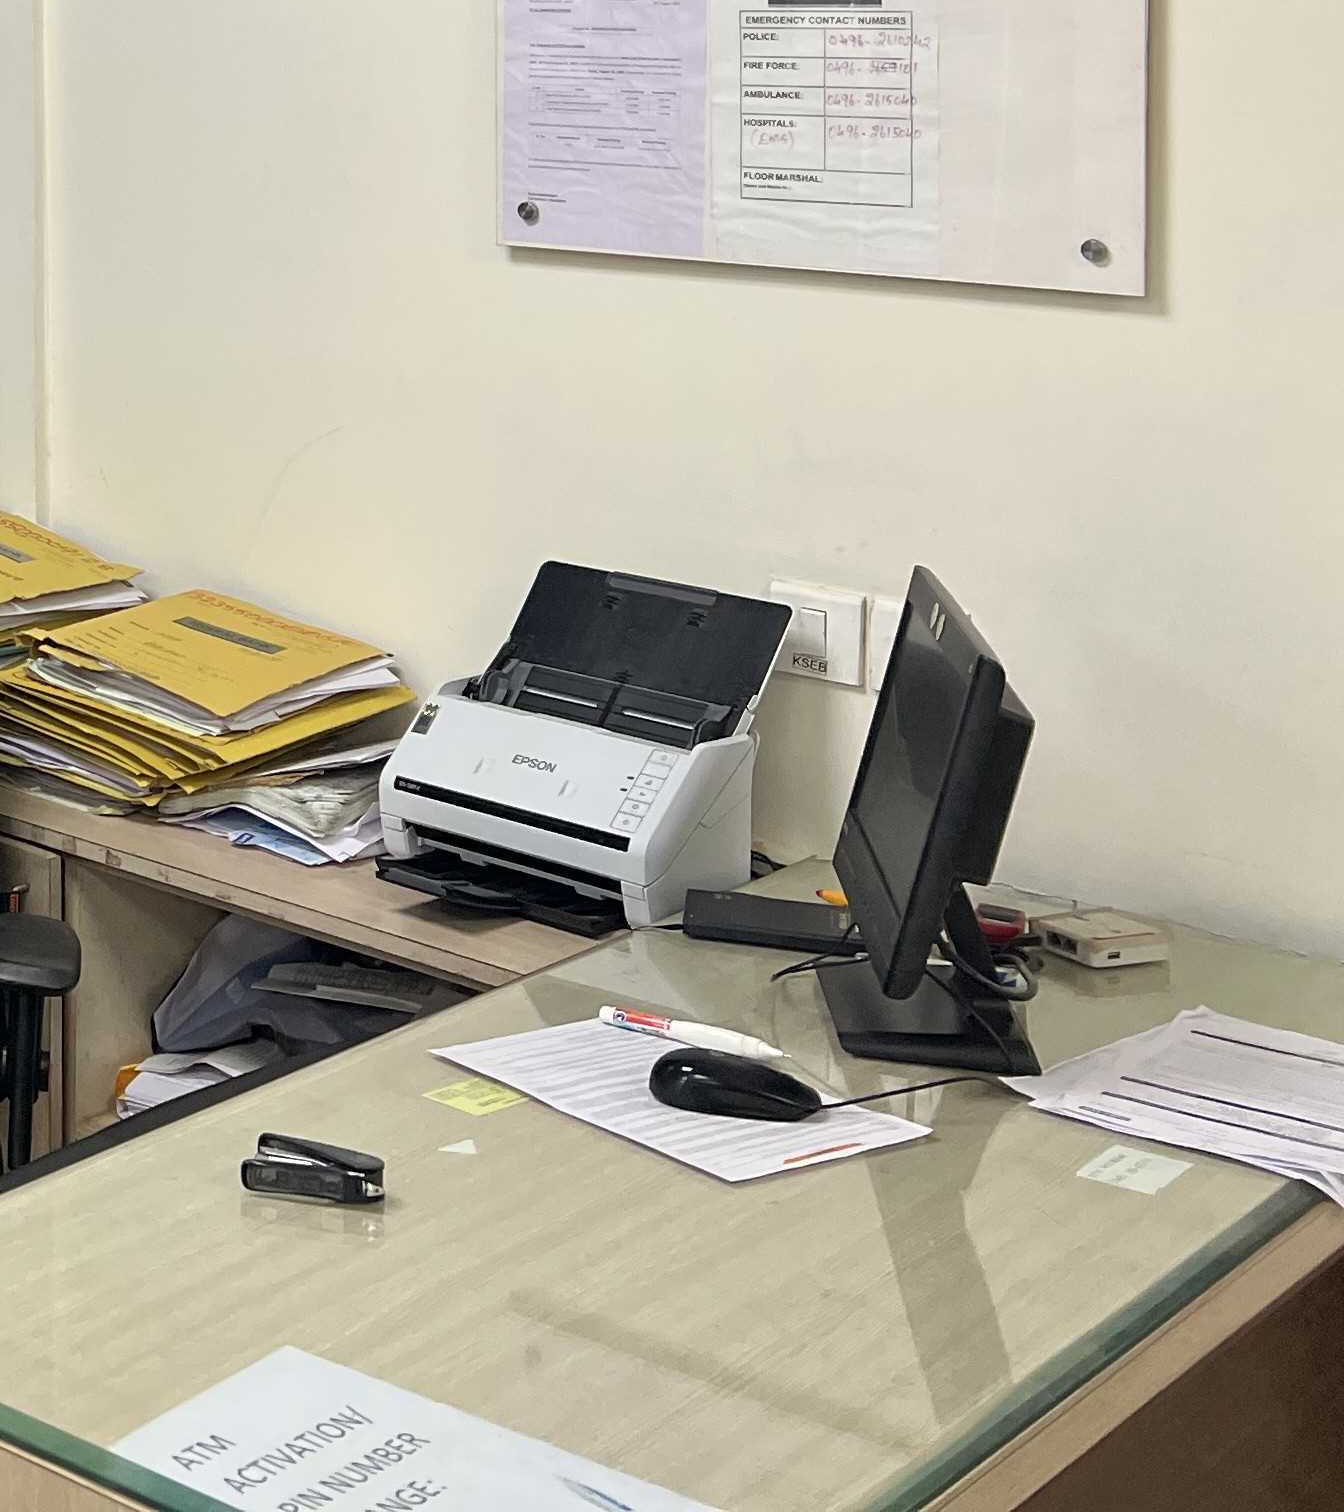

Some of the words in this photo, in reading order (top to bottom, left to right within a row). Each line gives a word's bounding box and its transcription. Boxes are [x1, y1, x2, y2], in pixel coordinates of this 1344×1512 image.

[745, 16, 806, 25] EMERGENCY
[808, 16, 855, 25] CONTACT
[858, 17, 906, 25] NUMBERS
[743, 61, 763, 70] FIRE
[743, 172, 774, 182] FLOOR
[792, 654, 828, 673] KSEB
[512, 753, 558, 773] EPSON
[171, 1433, 237, 1472] ATM
[223, 1404, 374, 1495] ACTIVATION/
[277, 1488, 334, 1512] PIN
[318, 1432, 432, 1494] NUMBER
[365, 1479, 448, 1512] NGE:
